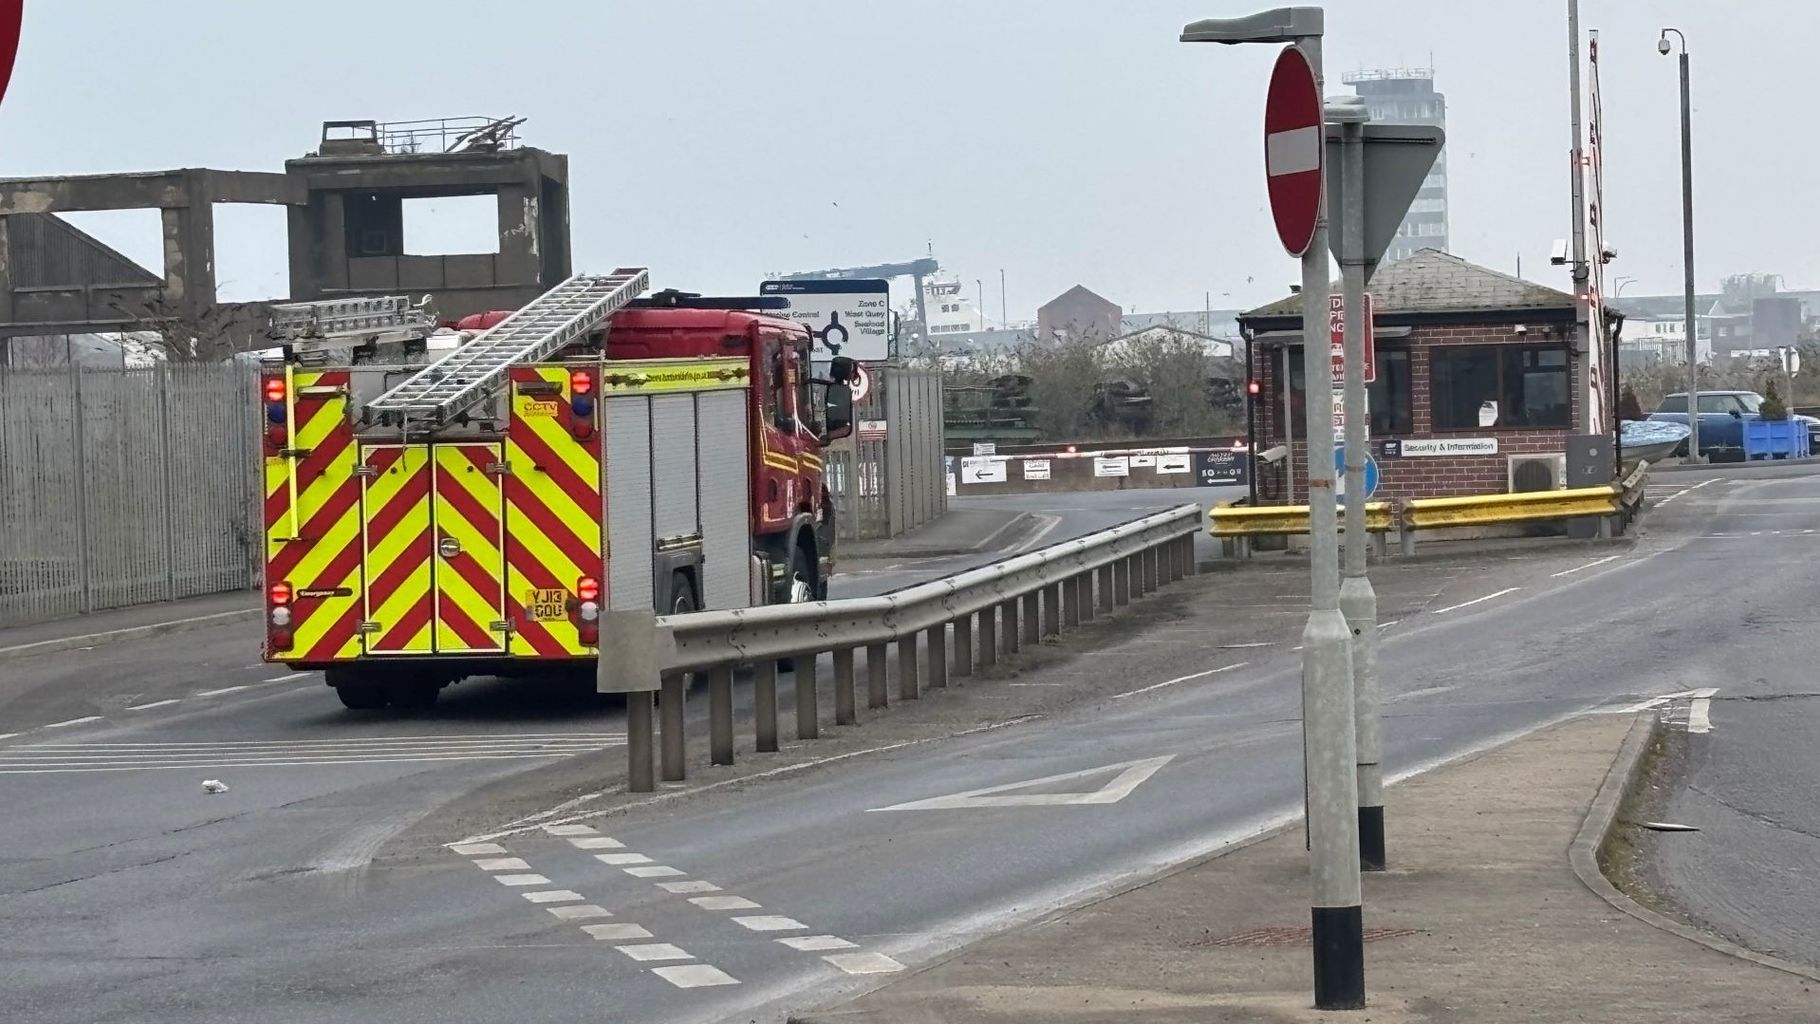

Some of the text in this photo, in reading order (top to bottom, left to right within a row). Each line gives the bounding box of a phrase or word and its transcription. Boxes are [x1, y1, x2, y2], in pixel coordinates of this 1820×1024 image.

[858, 300, 877, 308] Zone
[865, 311, 885, 319] Quay
[860, 328, 885, 336] Village
[524, 402, 557, 411] CCTV
[1404, 444, 1437, 453] Security
[1440, 443, 1445, 451] &
[1447, 442, 1494, 451] Information
[533, 590, 562, 604] YJ13
[535, 604, 562, 618] GOU
